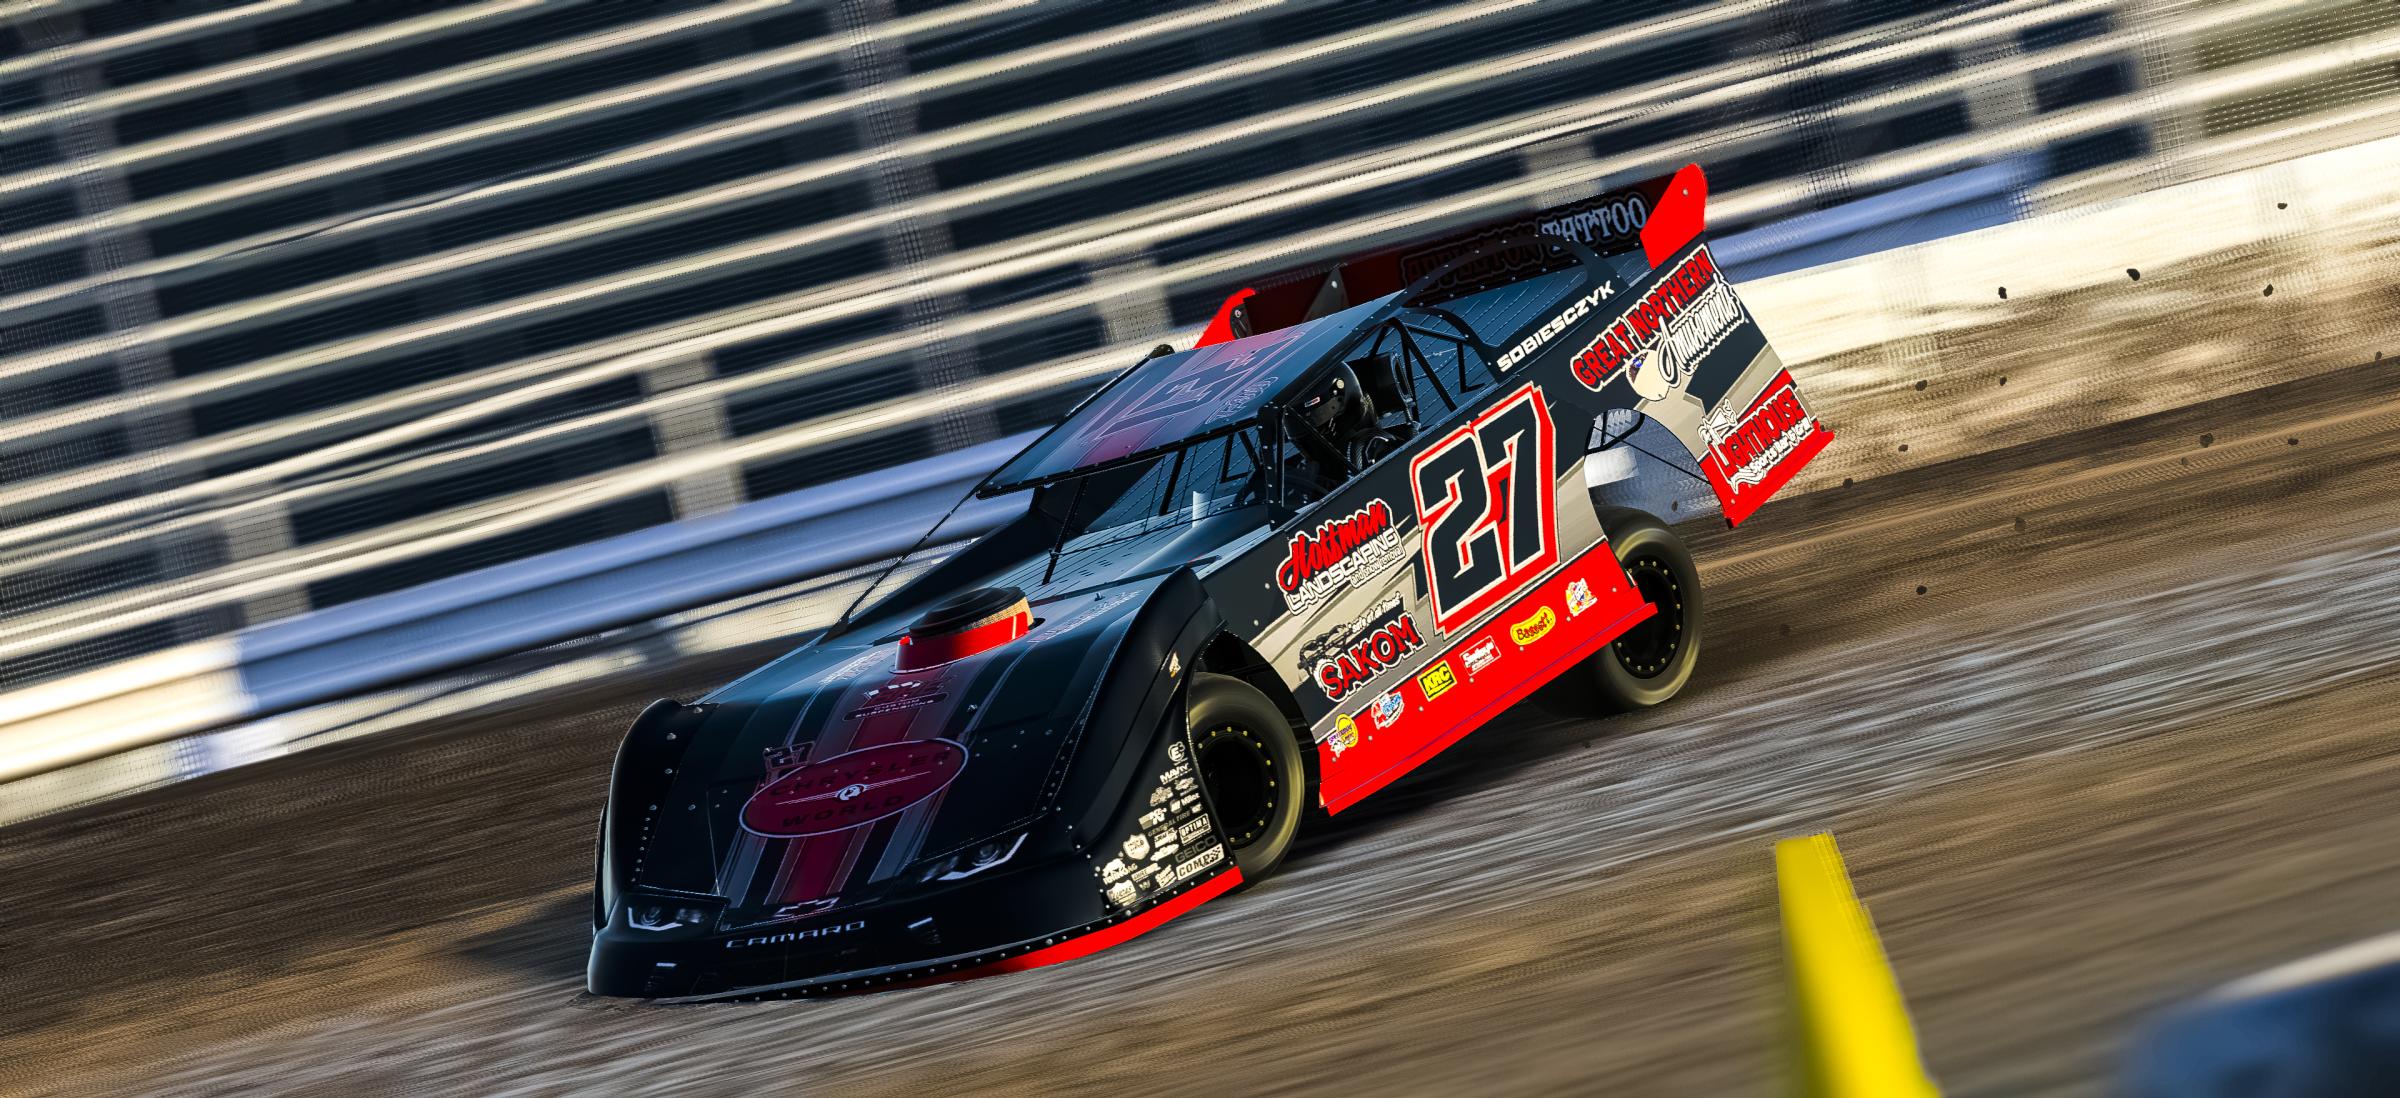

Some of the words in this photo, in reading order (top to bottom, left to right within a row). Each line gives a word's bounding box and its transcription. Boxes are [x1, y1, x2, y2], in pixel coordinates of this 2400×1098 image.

[1539, 197, 1647, 252] TATTOO
[1496, 280, 1615, 373] SOBIESCZYK
[1572, 323, 1635, 386] GREAT
[1626, 250, 1714, 341] NORTHERN
[1658, 273, 1740, 382] Amusements
[1707, 387, 1807, 479] LIGHTHOUSE
[1413, 395, 1548, 624] 27
[1286, 527, 1400, 612] LANDSCAPING
[1320, 615, 1420, 698] SAKOM
[1422, 666, 1451, 695] KRC
[770, 751, 952, 797] CHRYSLER
[782, 795, 906, 827] WORLD
[1174, 835, 1217, 863] GEICO
[725, 920, 866, 950] CAMARO
